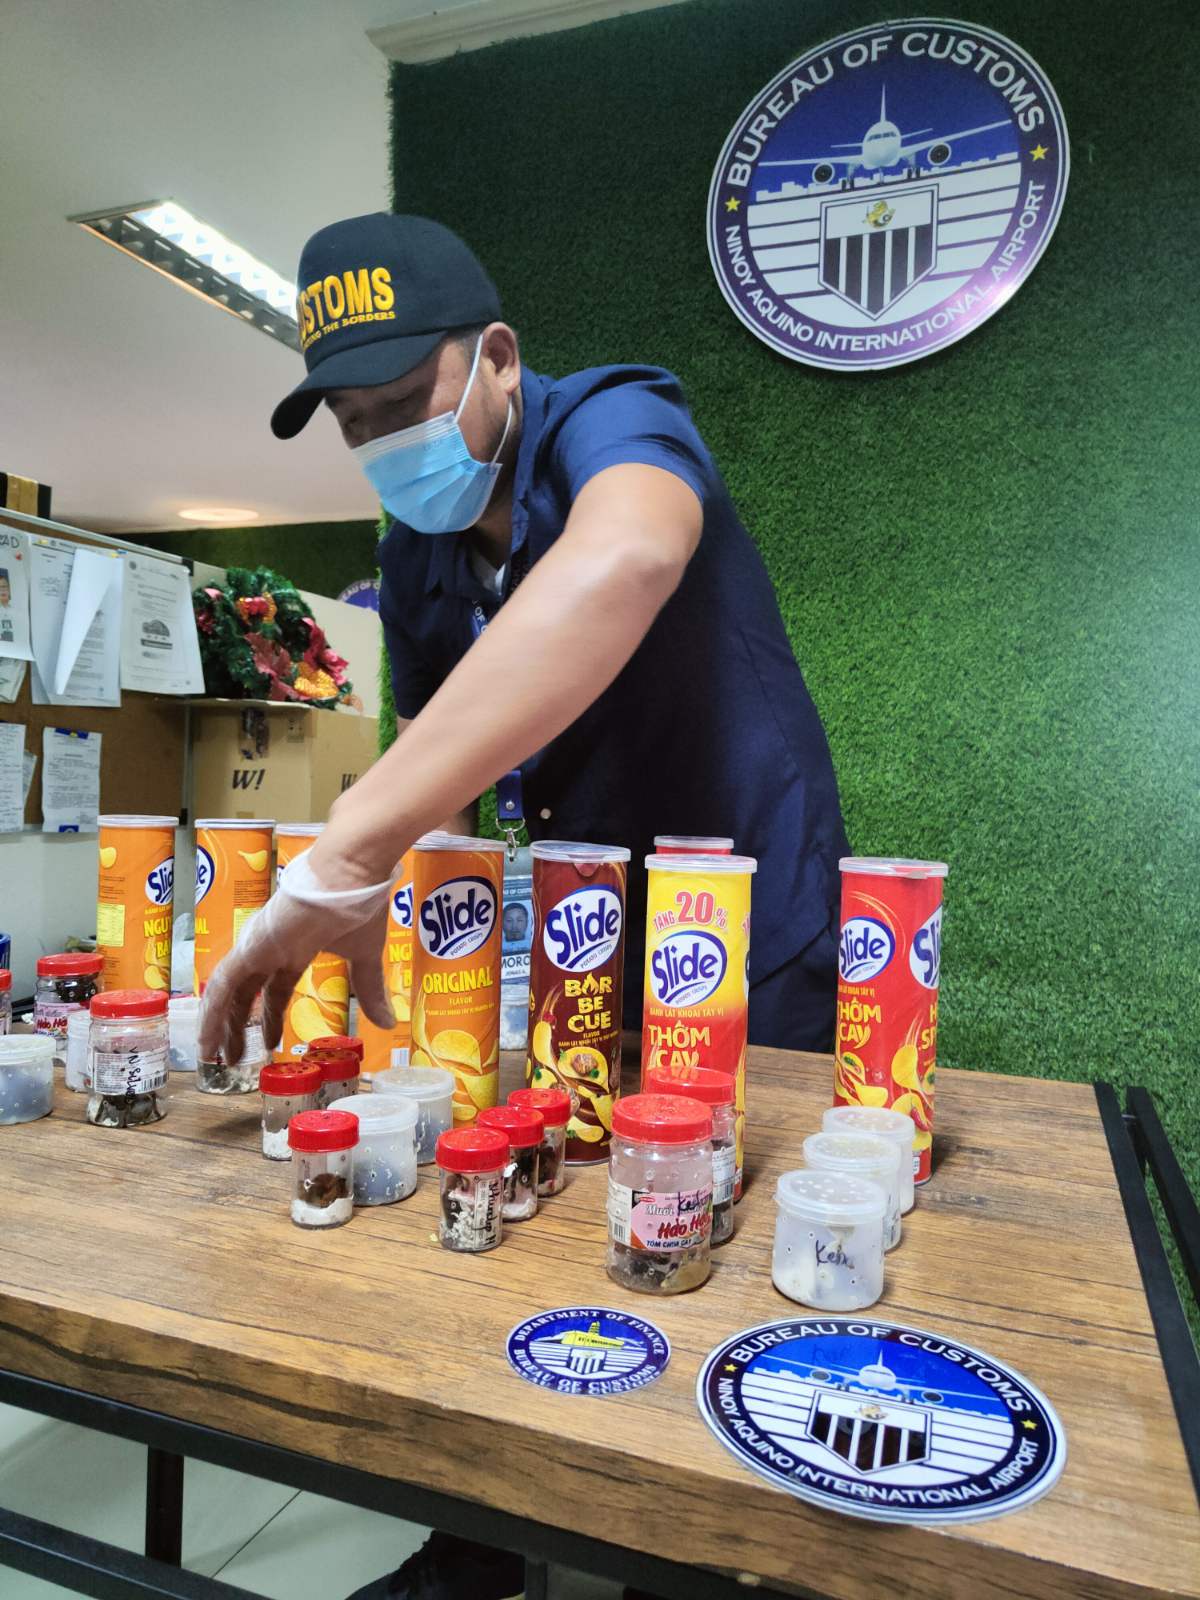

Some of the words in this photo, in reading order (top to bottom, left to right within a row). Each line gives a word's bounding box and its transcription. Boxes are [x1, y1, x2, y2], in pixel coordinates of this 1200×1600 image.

[727, 56, 834, 188] BUREAU
[842, 35, 893, 68] OF
[902, 32, 1045, 133] CUSTOMS
[725, 226, 756, 286] NINOY
[747, 284, 814, 342] AQUINO
[815, 283, 996, 351] INTERNATIONAL
[991, 180, 1046, 283] AIRPORT
[322, 321, 339, 335] THE
[342, 311, 396, 327] BORDERS
[232, 768, 266, 790] W!
[147, 863, 174, 902] Slid
[421, 888, 492, 953] Slide
[546, 898, 619, 965] Slide
[652, 943, 718, 999] Slide
[840, 927, 886, 974] Slide
[422, 966, 493, 994] ORIGINAL
[564, 972, 613, 997] BAR
[567, 1010, 611, 1033] CUE
[578, 996, 604, 1014] BE
[678, 1008, 700, 1018] KHOAI
[514, 1310, 600, 1342] DEPARTMENT
[606, 1313, 628, 1323] OF
[628, 1319, 665, 1356] FINANCE
[513, 1348, 555, 1382] BUREAU
[557, 1378, 582, 1389] OF
[588, 1364, 658, 1390] CUSTOMS
[730, 1323, 839, 1364] BUREAU
[847, 1325, 892, 1339] OF
[899, 1333, 1032, 1413] CUSTOMS
[719, 1377, 740, 1417] NINOY
[733, 1414, 794, 1470] AQUINO
[799, 1464, 993, 1504] INTERNATIONAL
[990, 1437, 1039, 1490] AIRPORT
